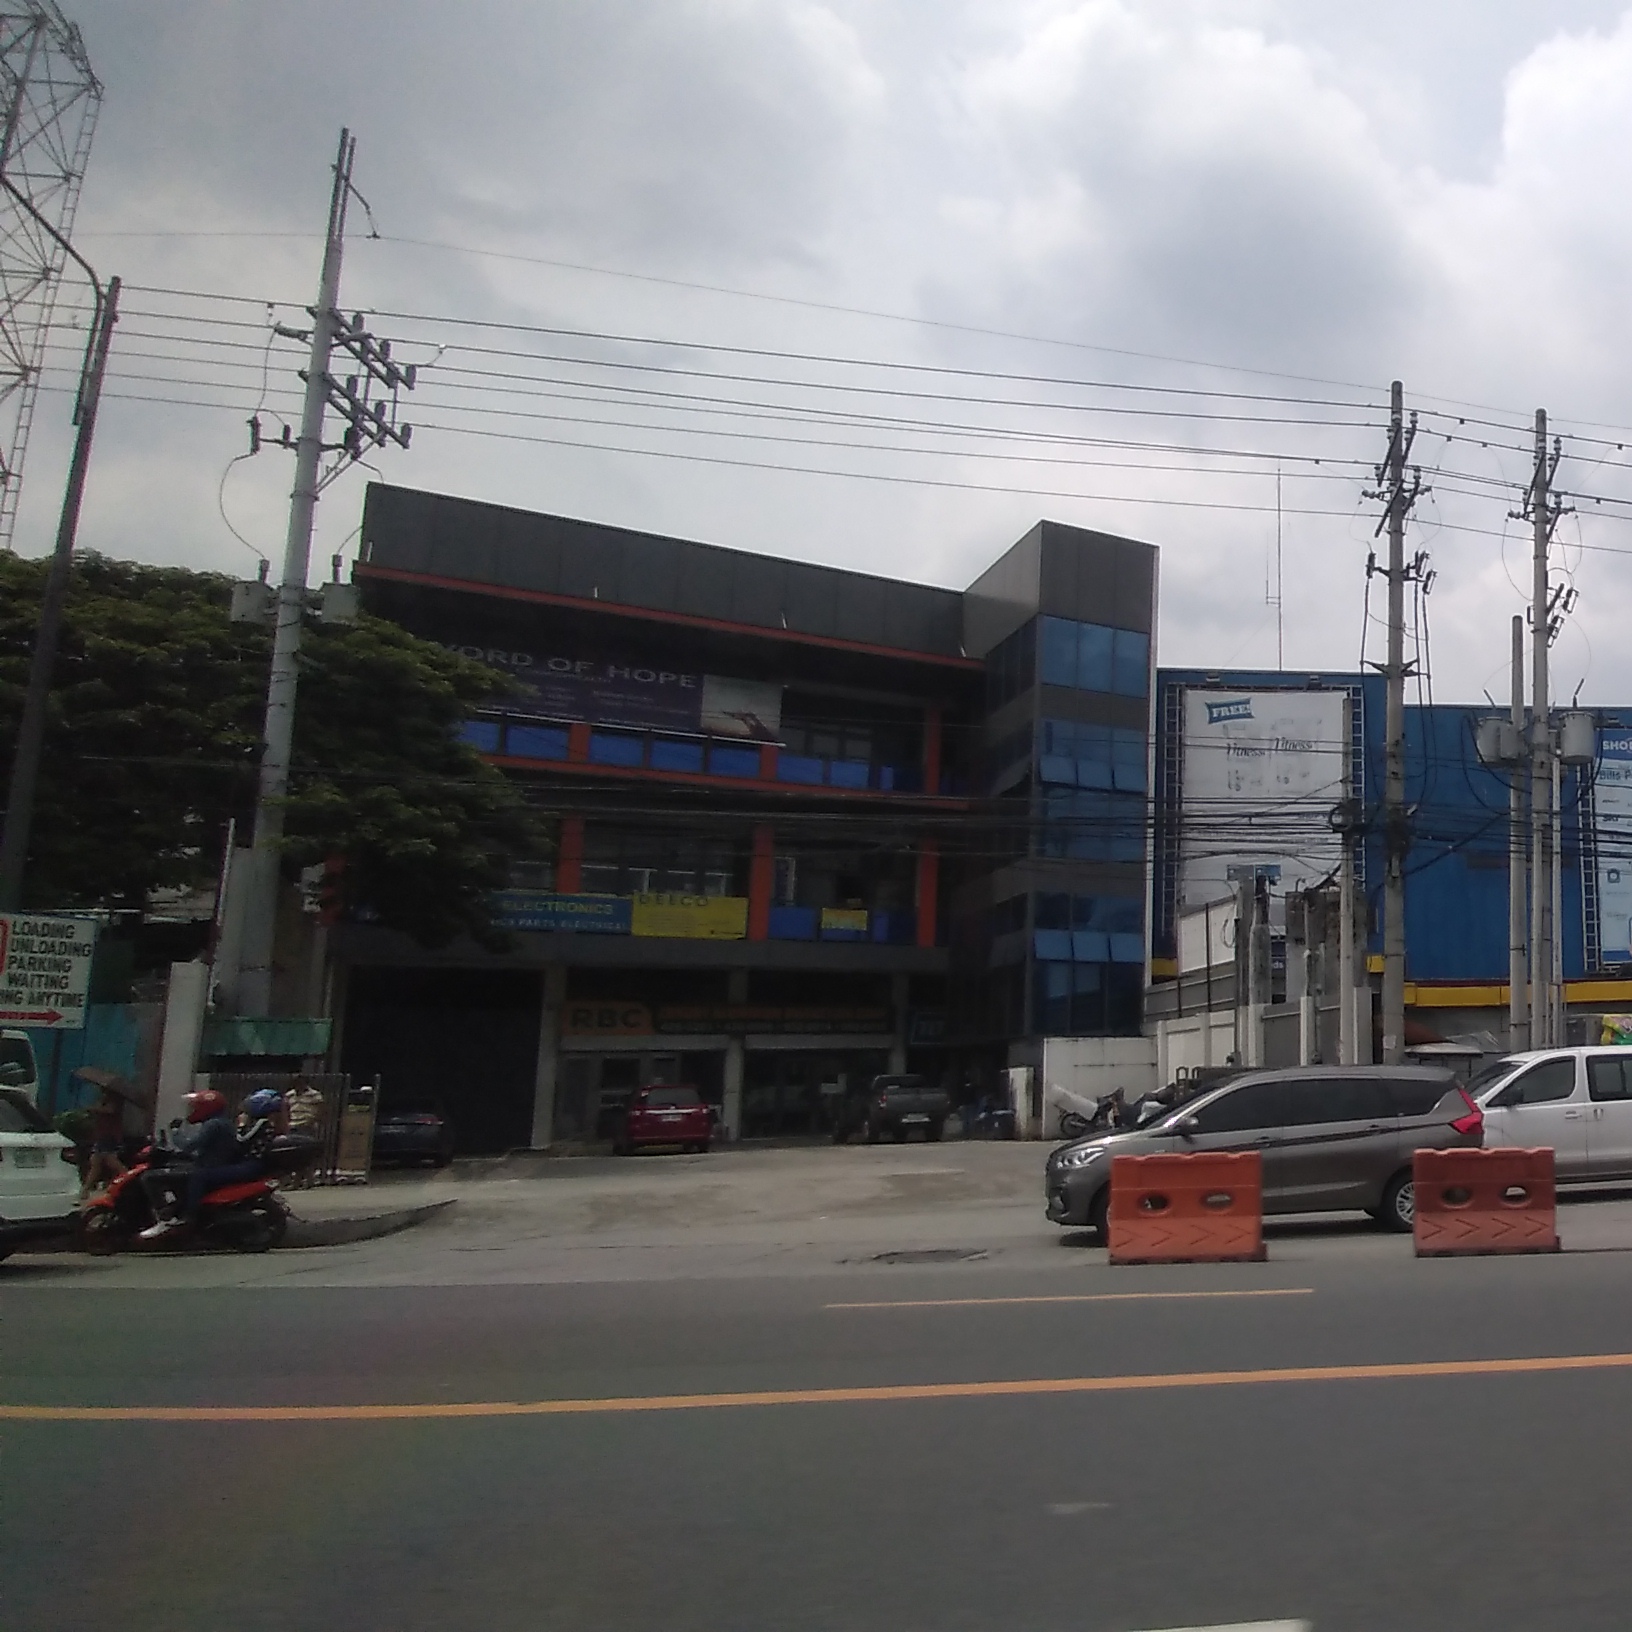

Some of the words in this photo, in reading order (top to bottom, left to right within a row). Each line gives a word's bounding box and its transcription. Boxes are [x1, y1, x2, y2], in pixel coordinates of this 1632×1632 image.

[547, 656, 594, 674] OF
[608, 665, 697, 689] HOPE
[12, 920, 76, 939] LOADING
[10, 938, 92, 957] UNLOADING
[8, 955, 72, 973] PARKING
[8, 971, 69, 989] WAITING
[571, 1008, 644, 1029] RBC
